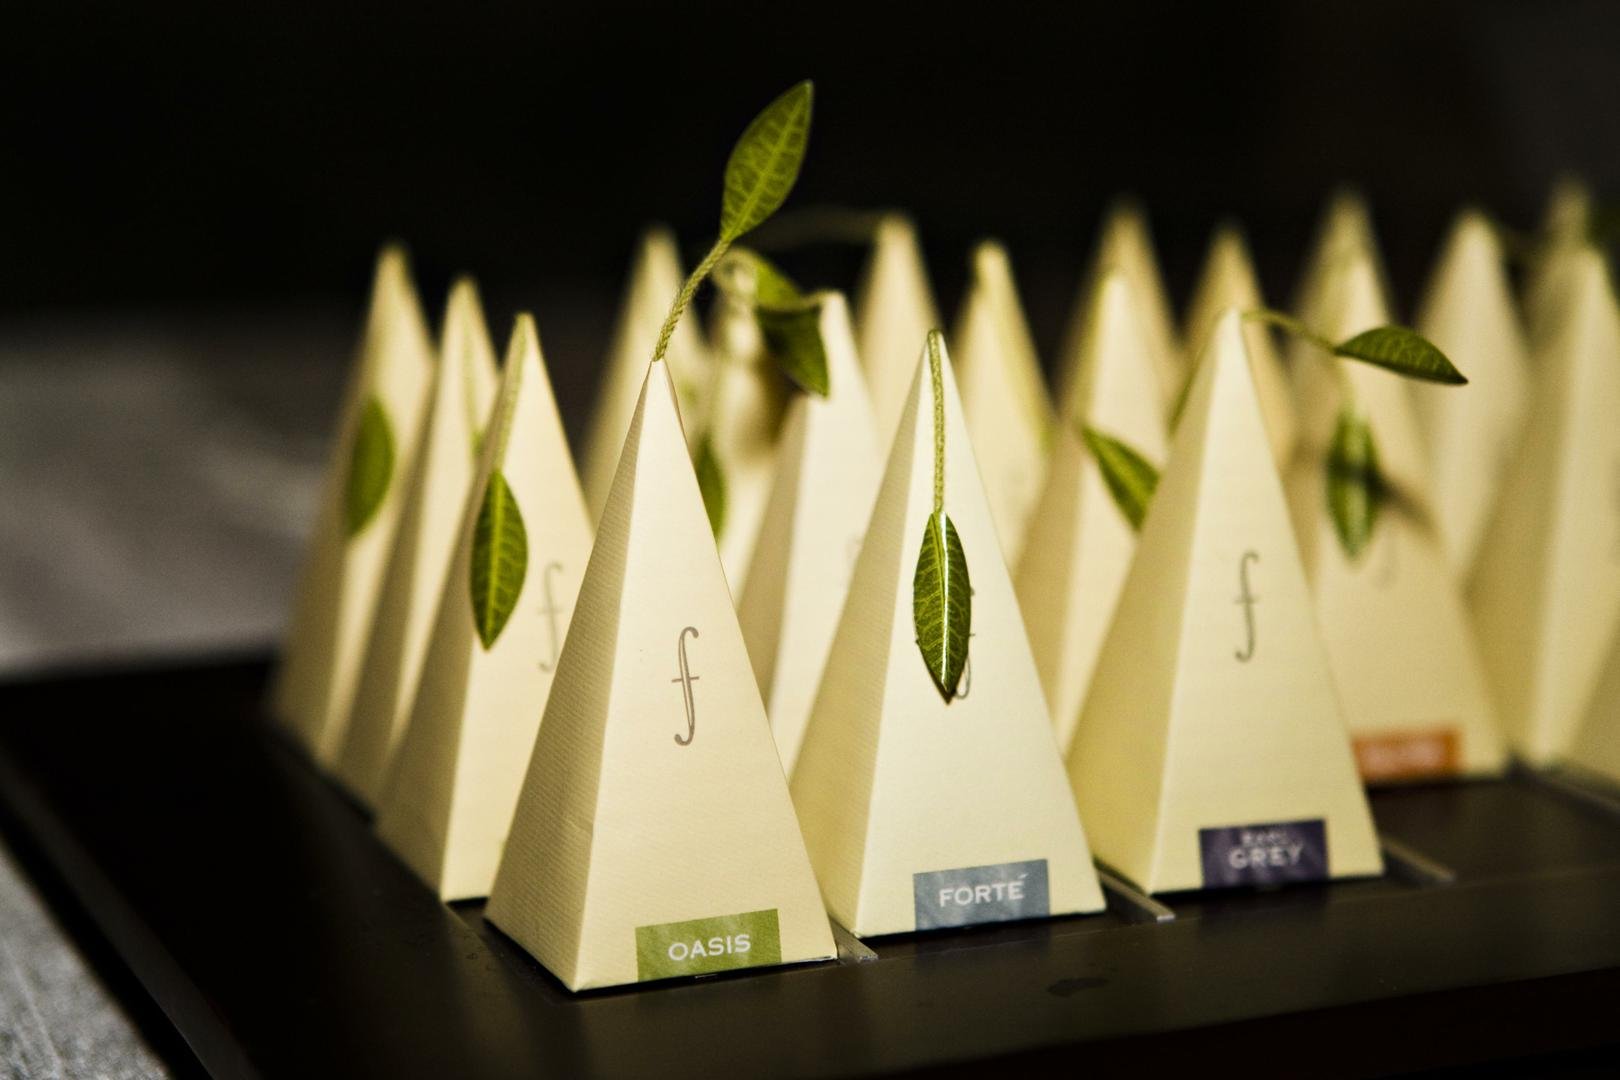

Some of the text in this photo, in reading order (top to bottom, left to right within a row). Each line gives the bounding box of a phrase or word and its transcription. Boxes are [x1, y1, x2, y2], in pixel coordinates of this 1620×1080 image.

[1233, 551, 1260, 662] f
[672, 626, 700, 746] f
[1228, 844, 1304, 870] GREY
[939, 873, 1028, 908] FORTÉ
[667, 934, 752, 961] OASIS
